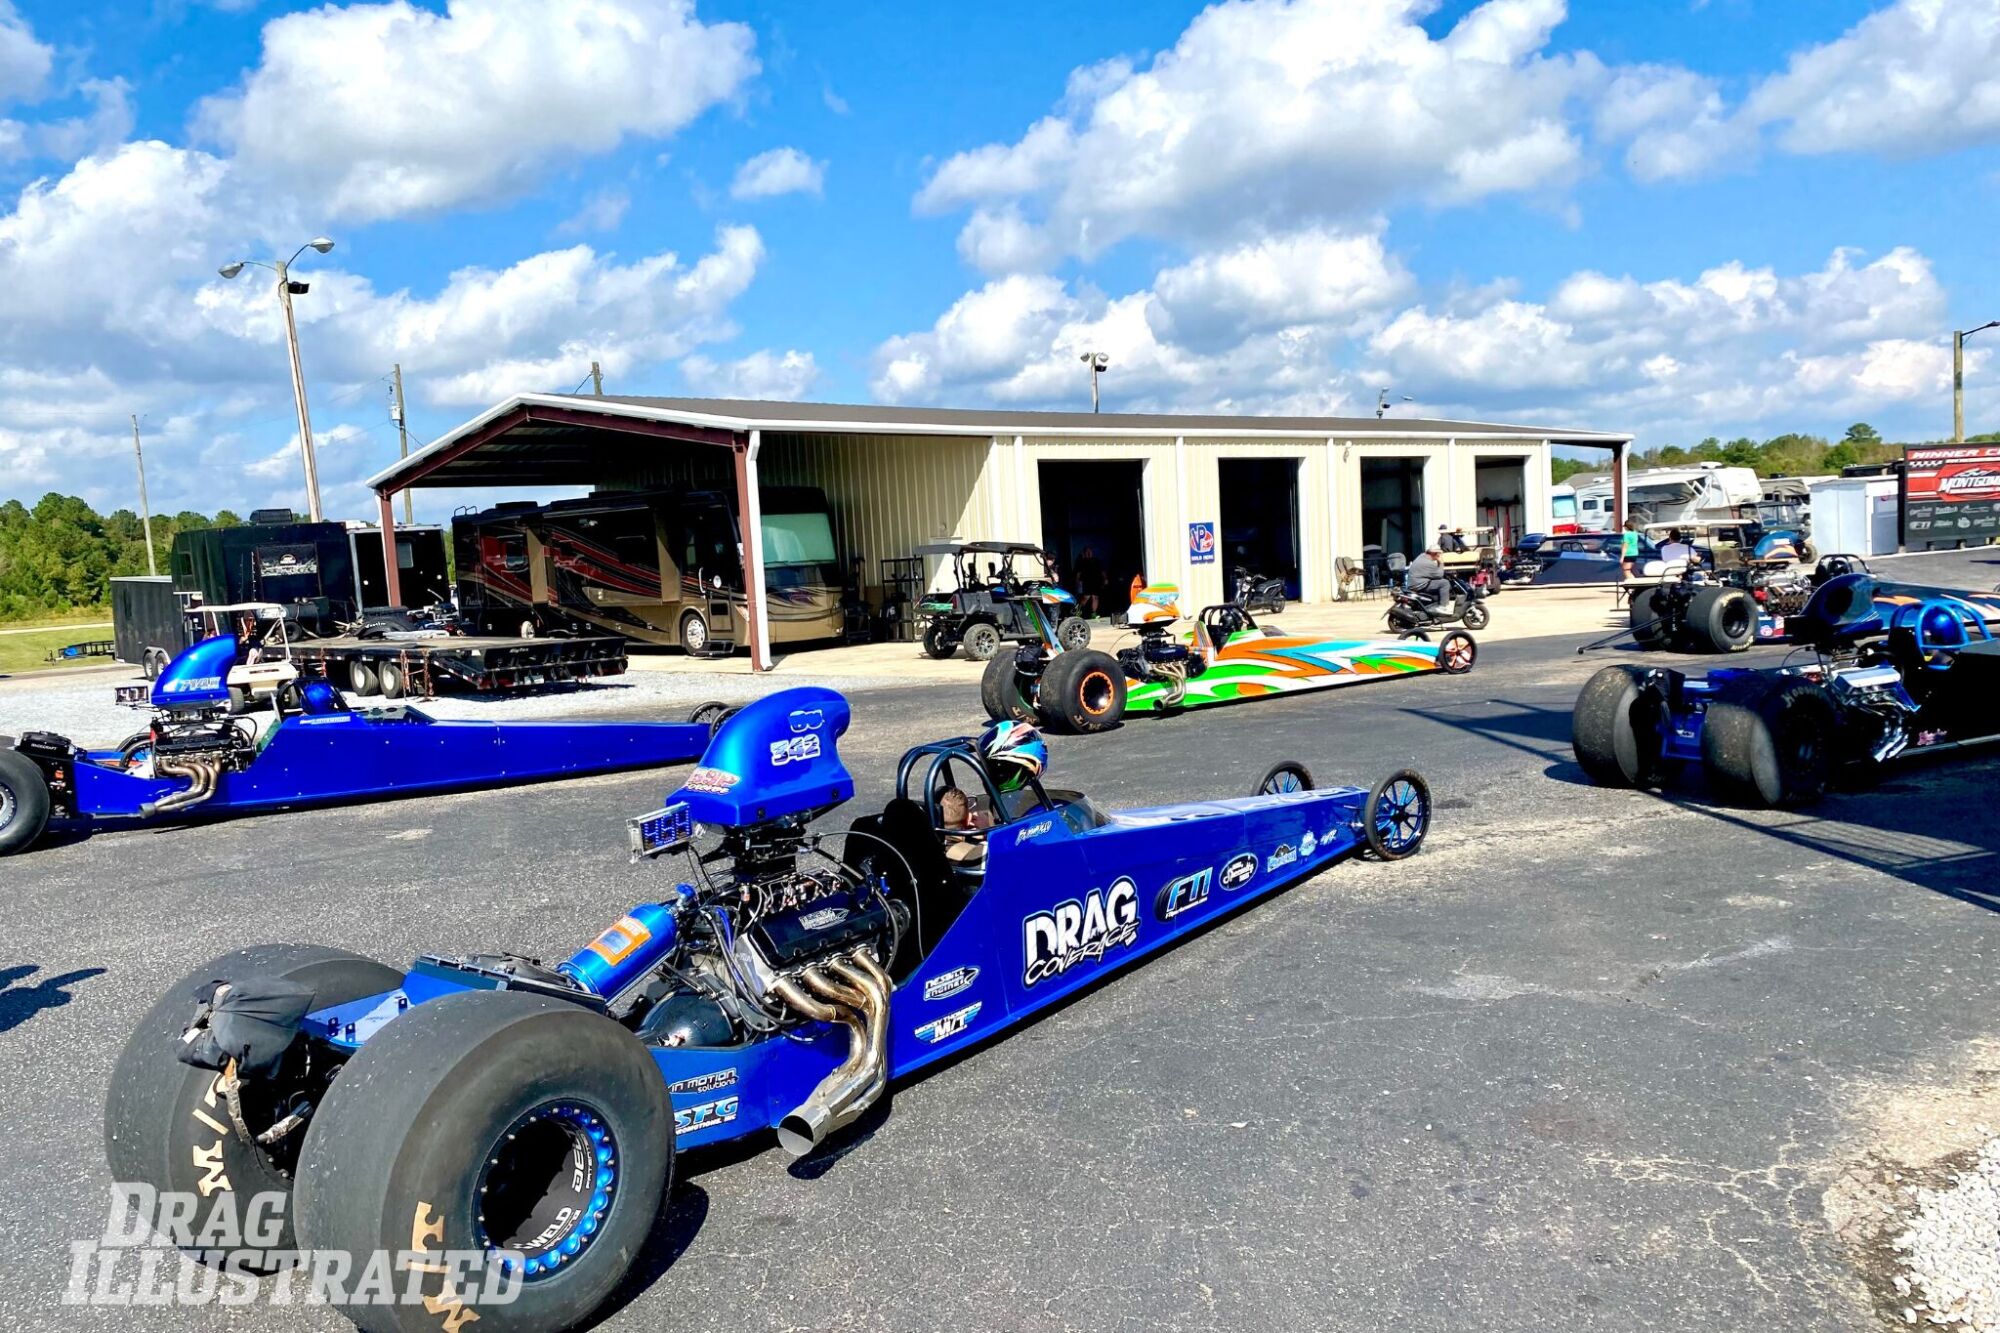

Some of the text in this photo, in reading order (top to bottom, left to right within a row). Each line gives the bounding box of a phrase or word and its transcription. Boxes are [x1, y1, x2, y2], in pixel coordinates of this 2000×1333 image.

[1911, 449, 1980, 459] WINNER
[770, 734, 820, 766] 342
[1166, 867, 1213, 912] FTI
[1025, 880, 1138, 967] DRAG
[1025, 921, 1140, 985] COVERAGE
[935, 1013, 968, 1038] M/T
[674, 1096, 739, 1129] SFG
[524, 1206, 572, 1250] WELD
